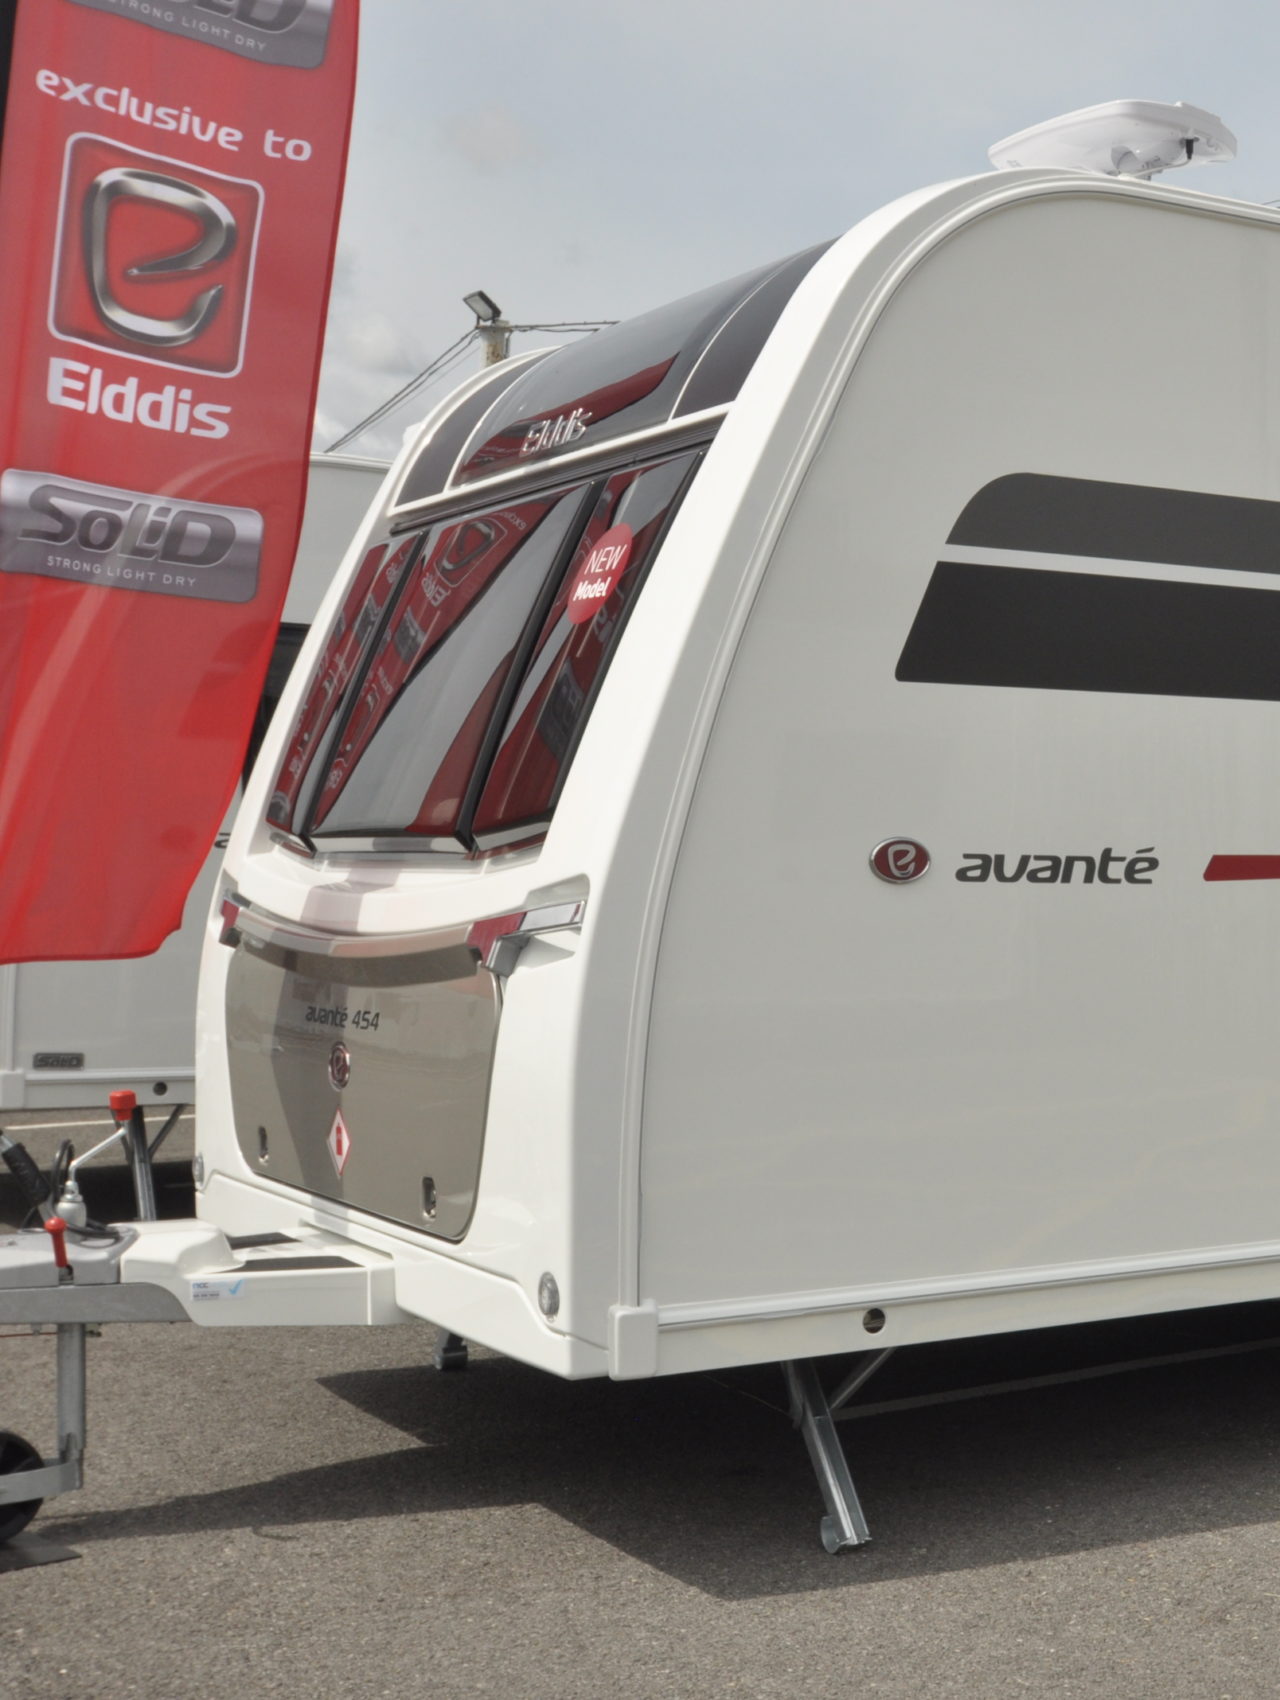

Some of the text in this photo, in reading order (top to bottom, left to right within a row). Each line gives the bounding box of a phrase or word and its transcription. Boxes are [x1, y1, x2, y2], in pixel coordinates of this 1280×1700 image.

[108, 0, 175, 22] RONG
[181, 15, 231, 40] LIGHT
[234, 33, 267, 52] DRY
[36, 68, 313, 162] exclusive to
[47, 356, 233, 440] Elddis
[47, 555, 197, 588] STRONG LIGHT DRY
[583, 543, 628, 576] NEW
[572, 576, 612, 602] Model
[954, 847, 1160, 885] avanté
[304, 1005, 381, 1032] avanté 454
